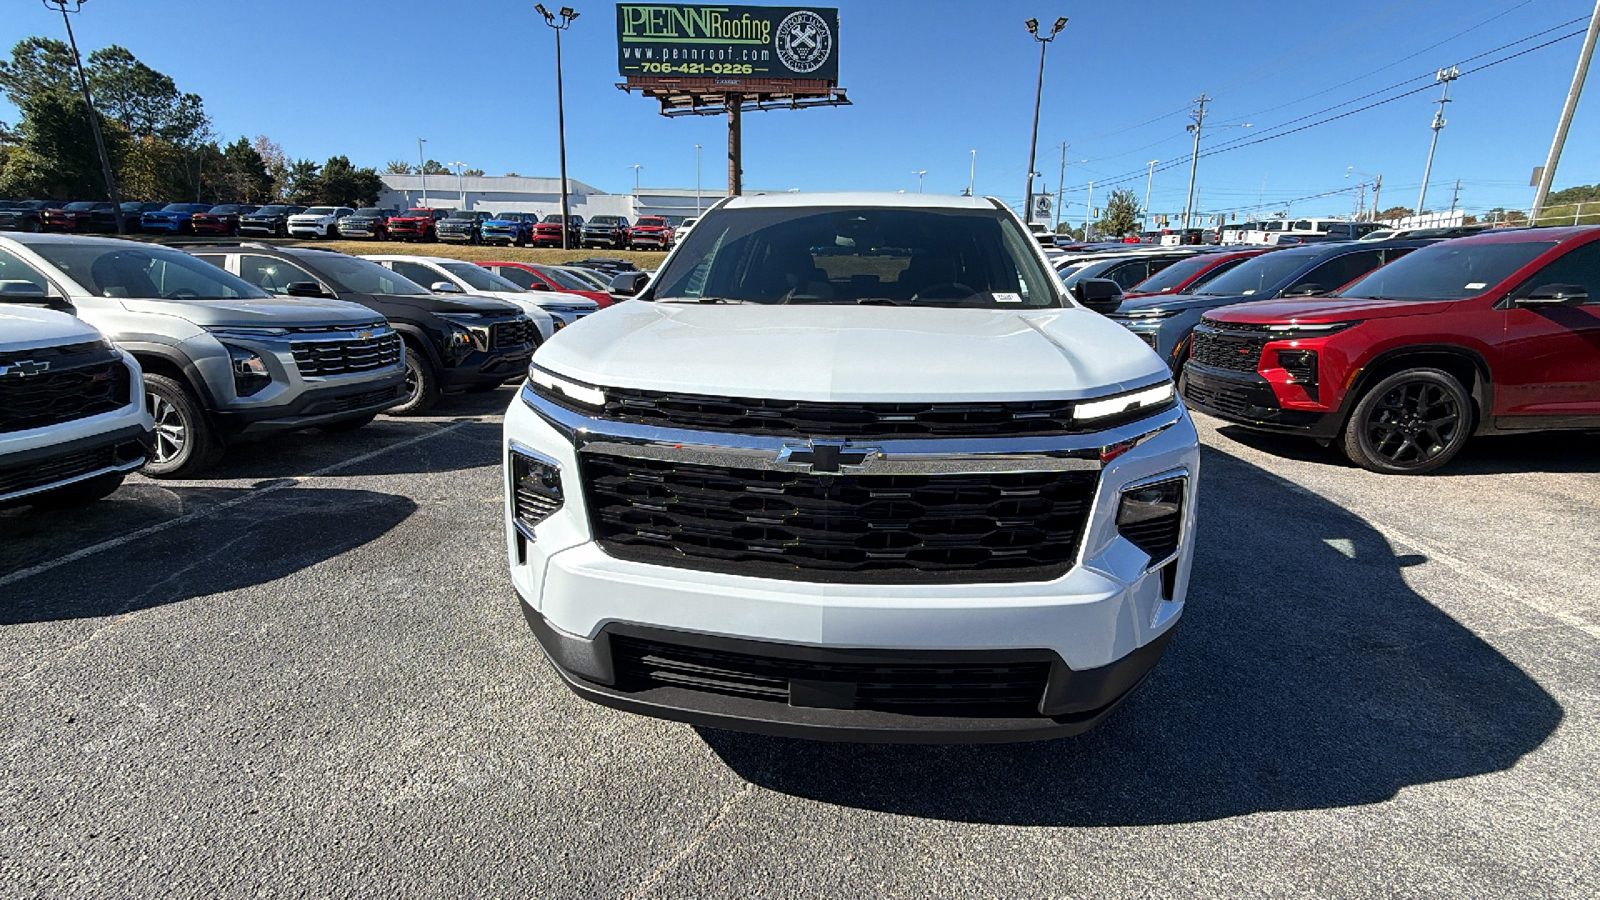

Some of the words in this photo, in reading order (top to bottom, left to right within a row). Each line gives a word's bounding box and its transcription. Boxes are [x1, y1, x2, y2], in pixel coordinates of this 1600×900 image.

[622, 6, 728, 37] PENN
[711, 14, 771, 44] Roofing
[780, 15, 807, 38] SUPPORT
[623, 46, 769, 62] www.pennroof.com
[641, 63, 752, 74] 706-421-0226
